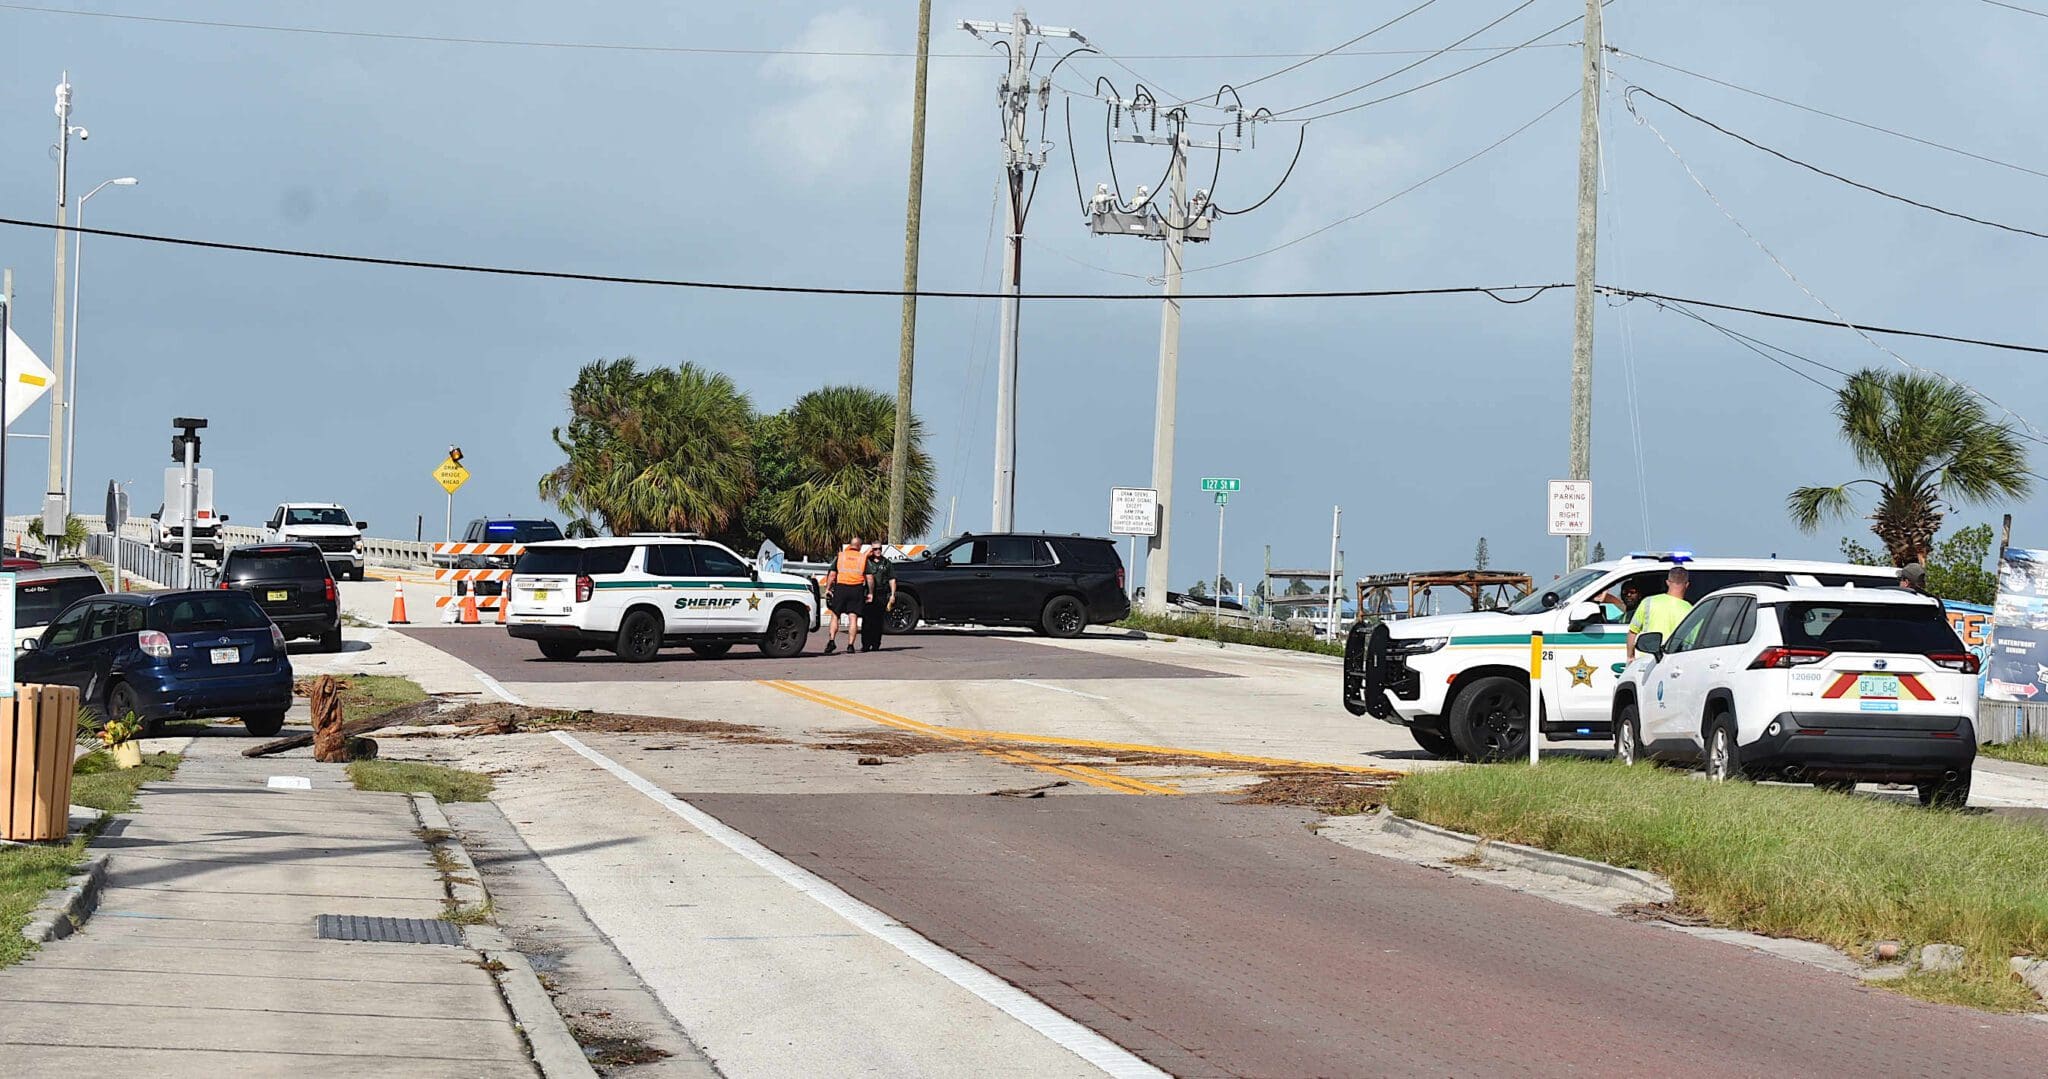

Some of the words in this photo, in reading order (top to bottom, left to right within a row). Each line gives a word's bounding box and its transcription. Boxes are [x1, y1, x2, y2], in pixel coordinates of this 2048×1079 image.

[1206, 479, 1218, 490] 127
[674, 597, 742, 610] SHERIFF
[1882, 681, 1897, 693] 642
